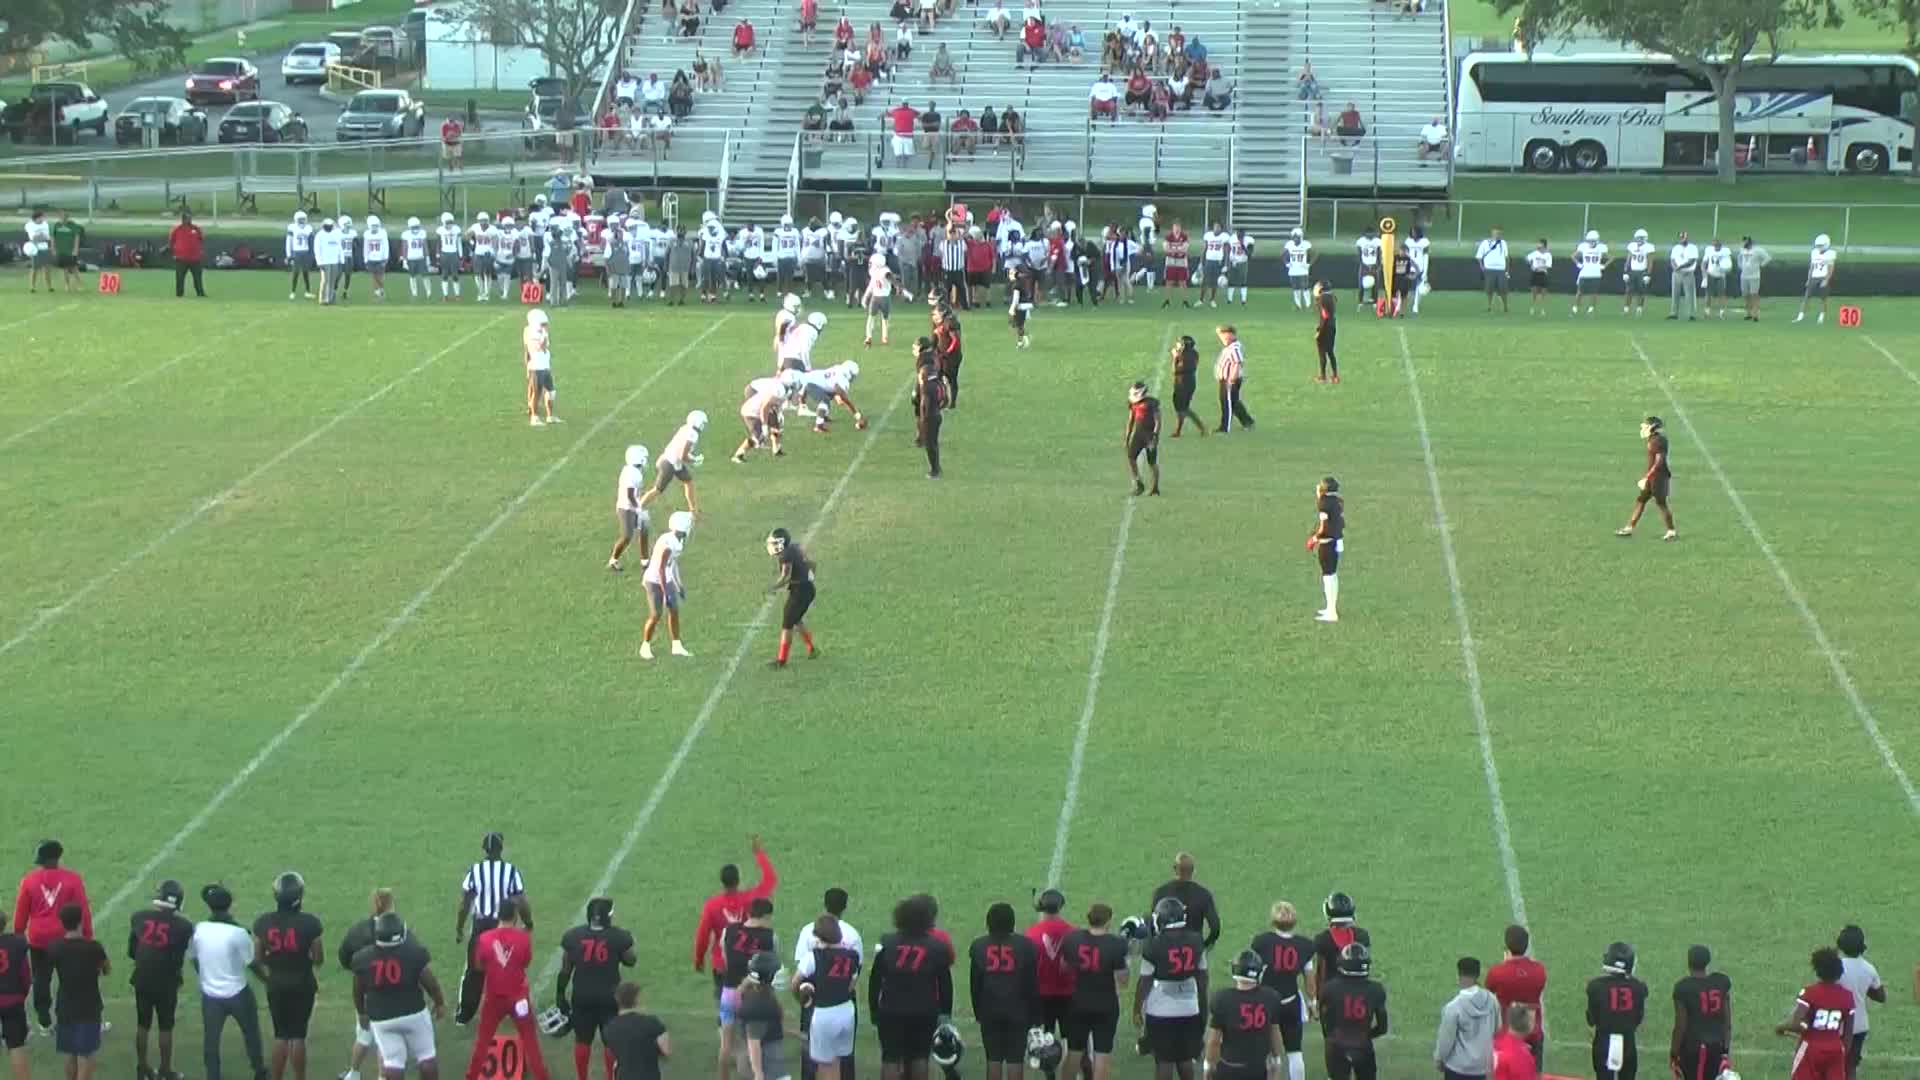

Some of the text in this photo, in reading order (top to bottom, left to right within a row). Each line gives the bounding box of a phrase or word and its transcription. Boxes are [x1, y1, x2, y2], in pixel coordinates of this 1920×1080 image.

[1530, 106, 1612, 126] Southern
[100, 275, 117, 291] 30
[523, 286, 539, 300] 40
[1841, 308, 1858, 325] 30
[141, 920, 169, 946] 25
[267, 928, 298, 951] 54
[580, 939, 608, 962] 76
[896, 945, 926, 969] 77
[986, 945, 1015, 971] 55
[1078, 945, 1100, 969] 51
[1168, 947, 1195, 973] 52
[1273, 944, 1298, 970] 10
[370, 960, 401, 984] 70
[828, 956, 851, 977] 21
[1344, 995, 1366, 1019] 16
[1610, 987, 1633, 1011] 13
[1700, 990, 1722, 1014] 15
[1239, 1003, 1266, 1029] 56
[482, 1039, 518, 1078] 50
